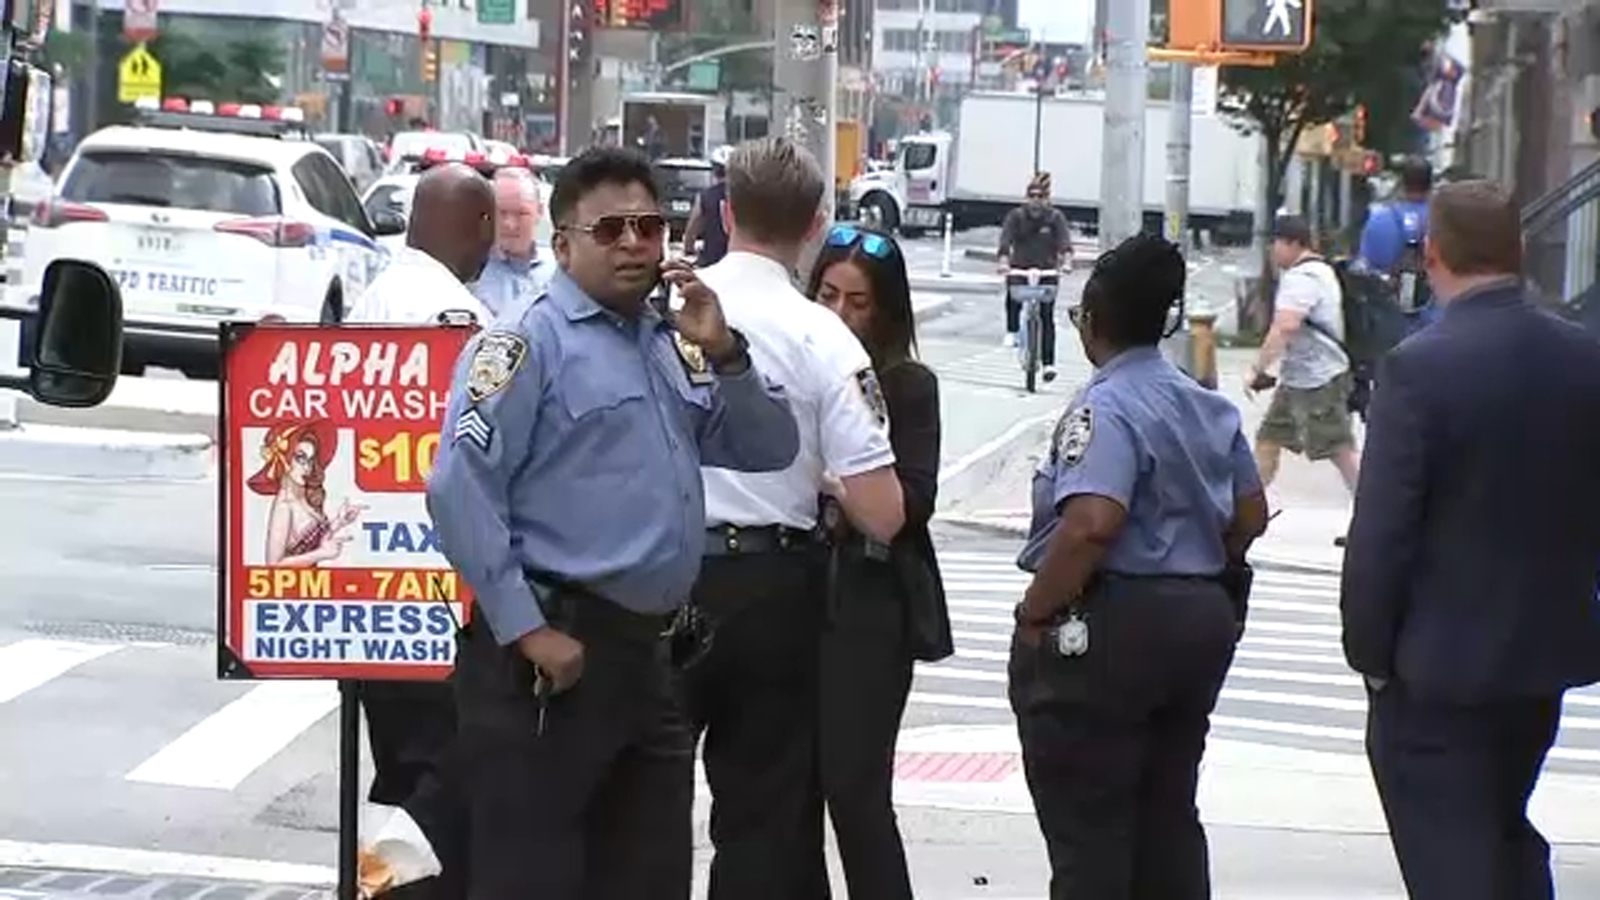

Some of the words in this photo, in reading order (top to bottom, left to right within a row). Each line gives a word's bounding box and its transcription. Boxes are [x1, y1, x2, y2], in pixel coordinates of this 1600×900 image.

[147, 272, 217, 296] TRAFFIC
[269, 341, 429, 387] ALPHA
[249, 389, 328, 418] CAR
[342, 389, 451, 419] WASH
[249, 569, 331, 599] 5PM
[372, 570, 456, 601] 7AM
[256, 603, 451, 635] EXPRESS
[256, 638, 353, 660] NIGHT
[364, 640, 451, 661] WASH
